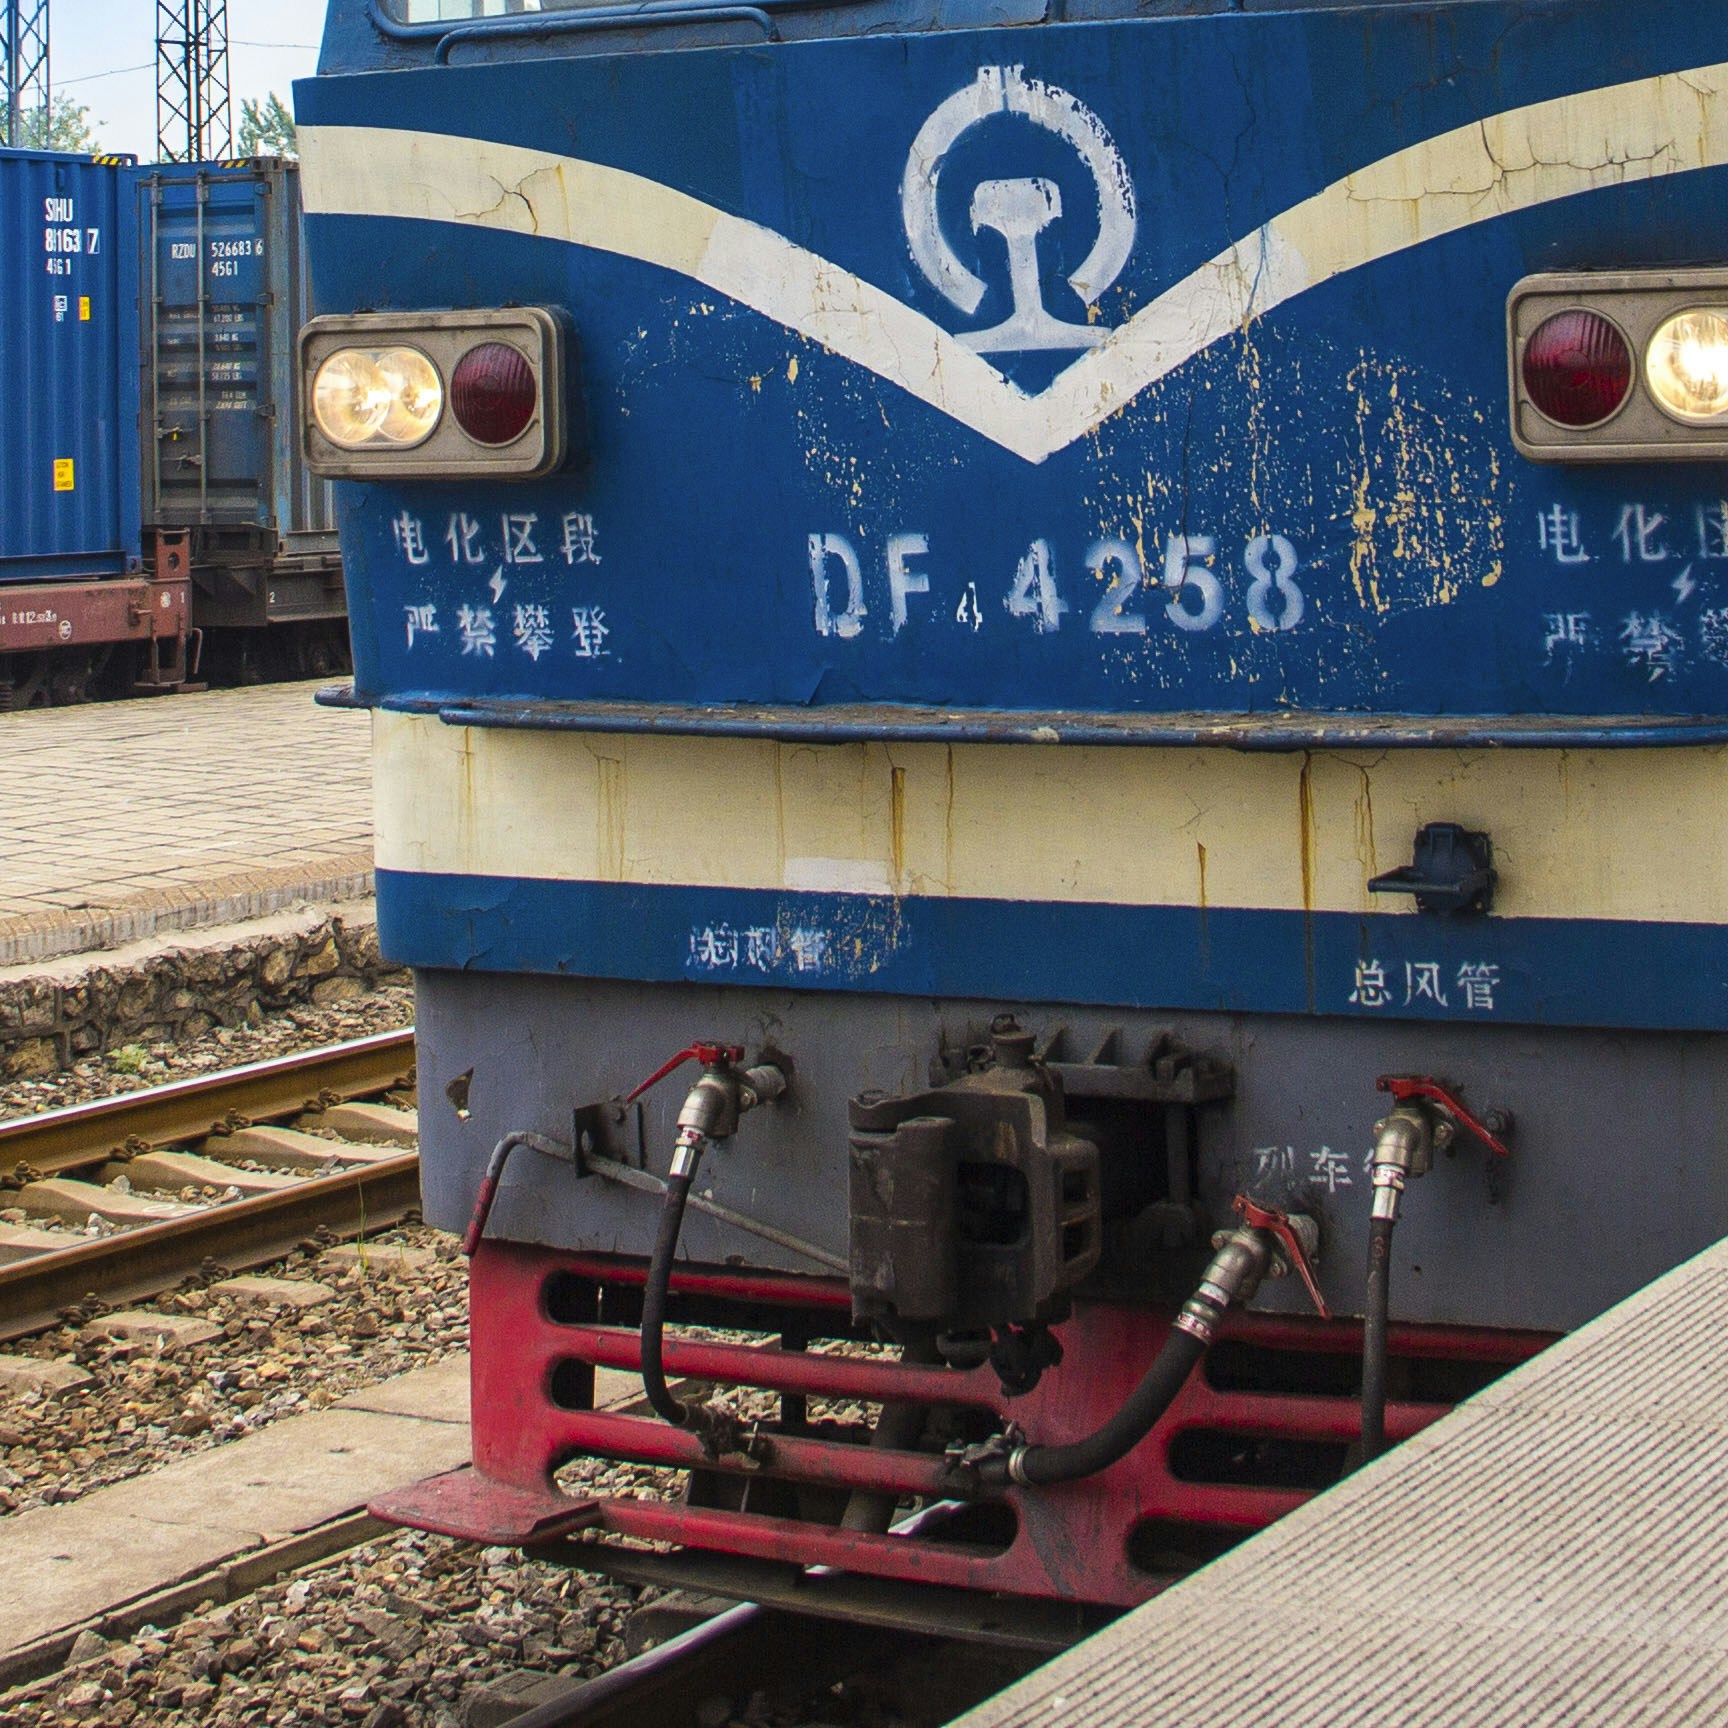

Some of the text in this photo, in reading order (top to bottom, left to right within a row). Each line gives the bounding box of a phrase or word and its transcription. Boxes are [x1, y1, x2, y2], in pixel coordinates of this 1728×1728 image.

[211, 240, 251, 257] 526683
[211, 260, 238, 277] 45G1
[393, 510, 602, 565] 电化区段
[1003, 534, 1305, 635] 4258
[403, 603, 611, 661] 严禁攀登
[1348, 959, 1500, 1010] 总风管
[1253, 1145, 1375, 1193] 列车
